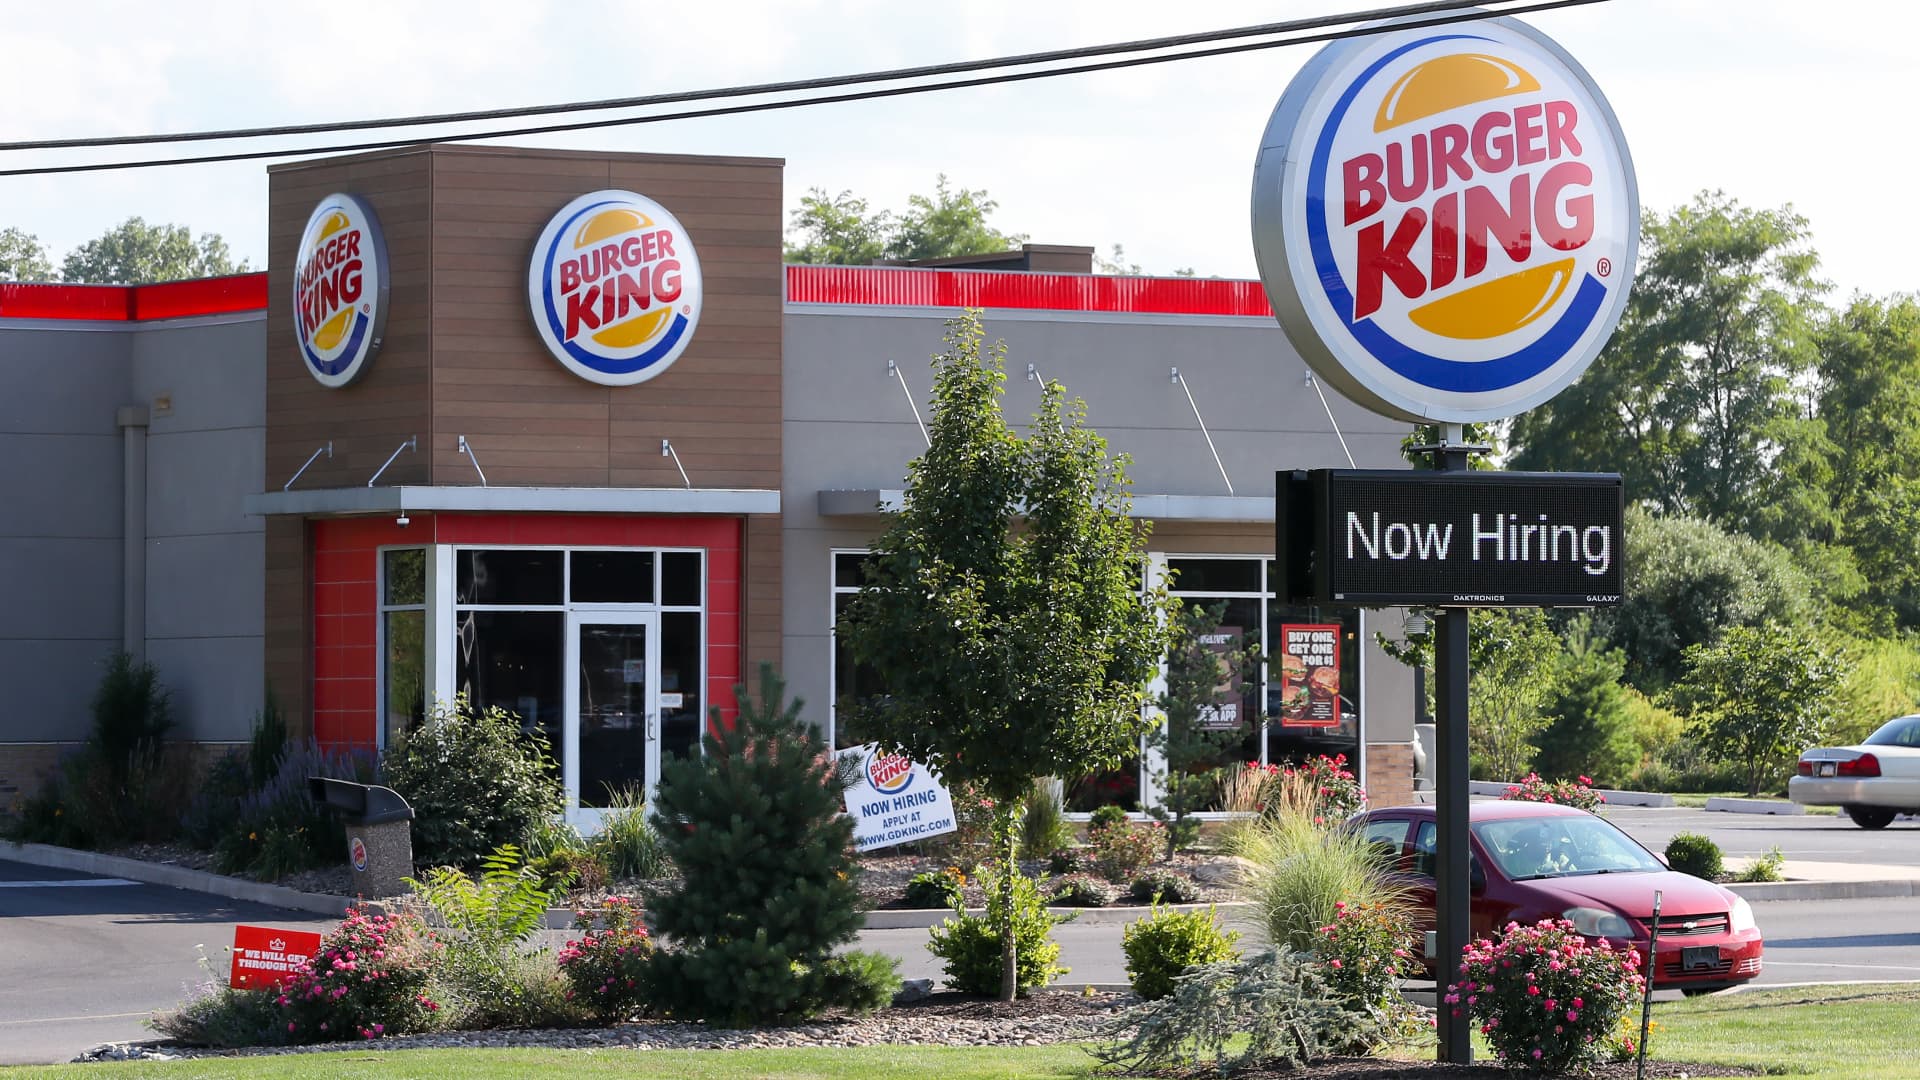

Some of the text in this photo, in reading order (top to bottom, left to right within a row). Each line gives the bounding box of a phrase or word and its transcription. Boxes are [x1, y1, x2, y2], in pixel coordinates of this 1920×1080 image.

[1342, 100, 1583, 227] BURGER
[1354, 161, 1595, 320] KING
[300, 229, 361, 299] BURGER
[560, 230, 675, 296] BURGER
[303, 259, 363, 344] KING
[565, 259, 682, 341] KING
[1347, 511, 1611, 575] Now Hiring
[1453, 594, 1505, 602] DAKTRONICS
[1288, 631, 1336, 644] BUY ONE,
[1288, 643, 1334, 654] GET ONE
[1302, 655, 1323, 666] FOR
[1220, 710, 1237, 721] APP
[870, 754, 901, 777] BURGE
[873, 757, 910, 787] KING
[861, 790, 937, 818] NOW HIRING
[883, 811, 921, 829] APPLY AT
[238, 958, 287, 971] THROUGH
[245, 949, 308, 964] WE WILL GET
